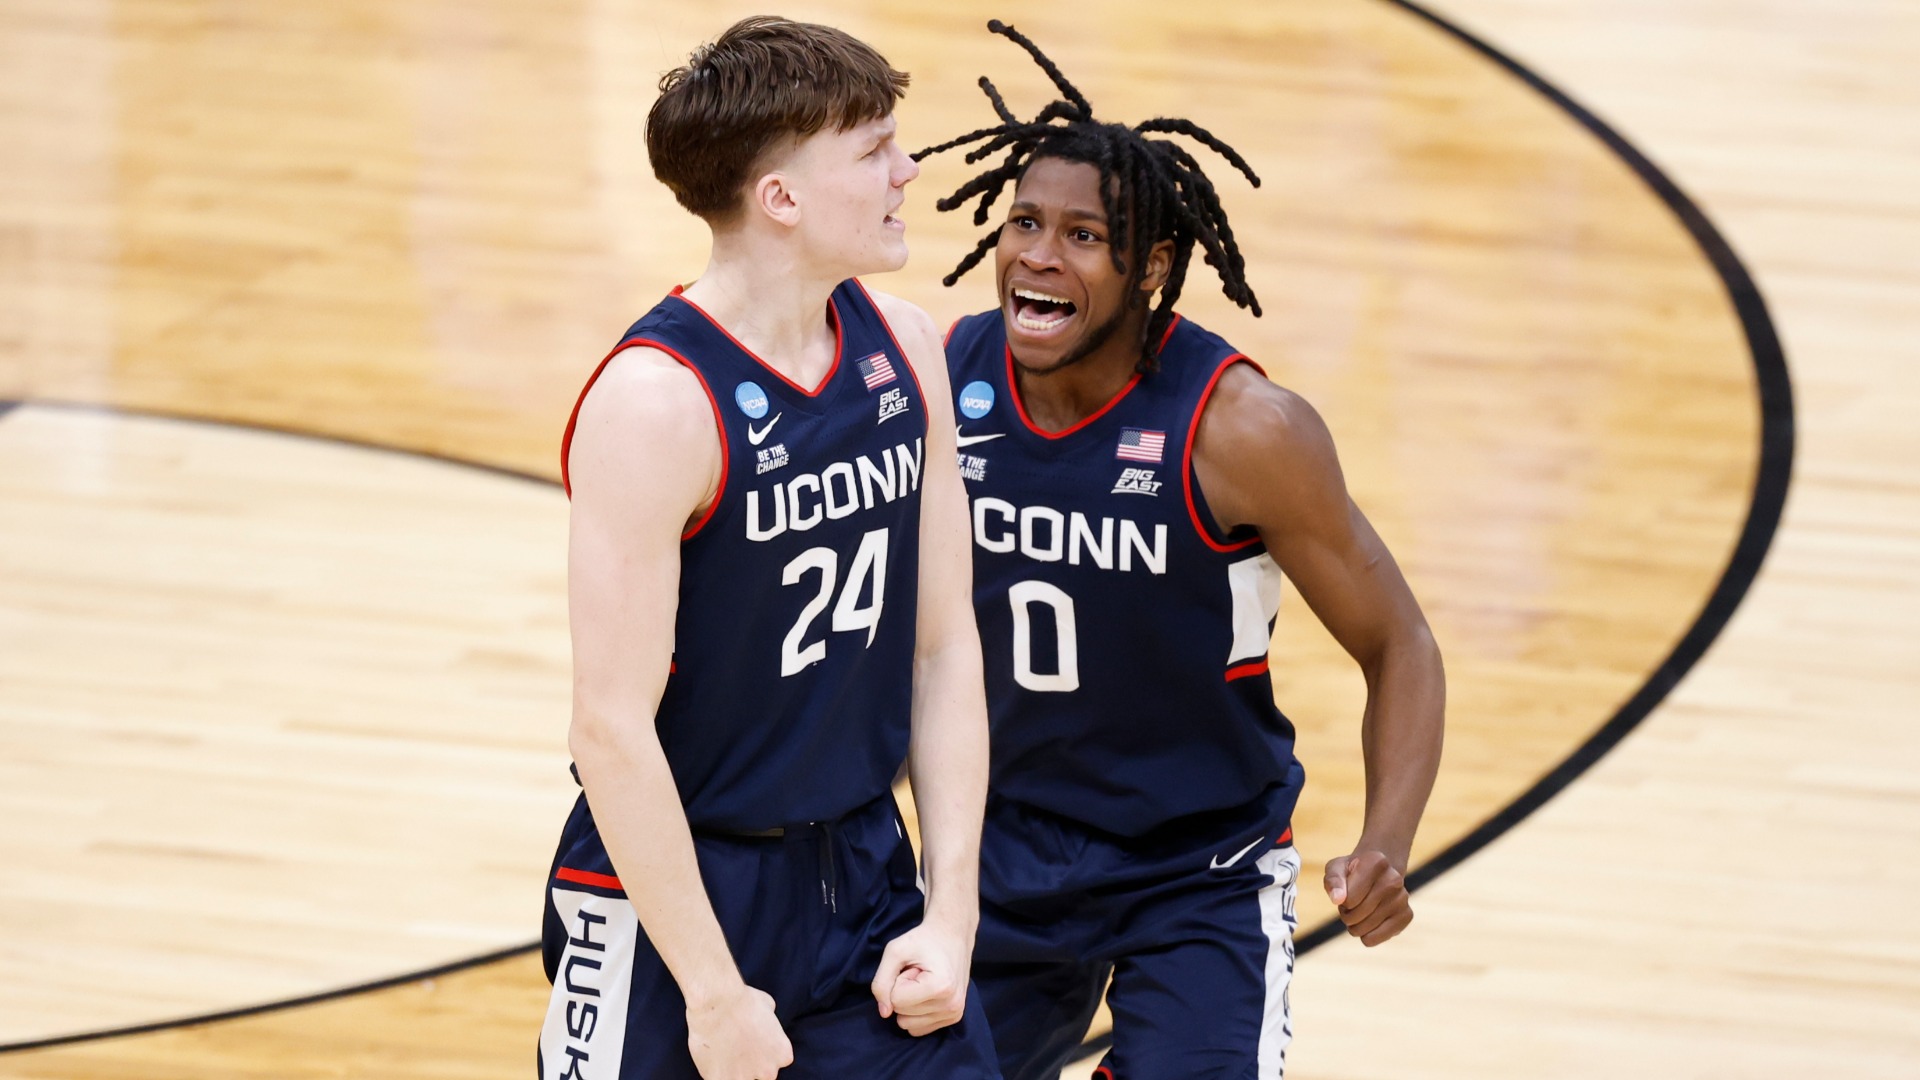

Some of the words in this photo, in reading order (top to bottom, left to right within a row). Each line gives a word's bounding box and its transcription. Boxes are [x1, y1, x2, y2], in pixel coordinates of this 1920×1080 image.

[742, 397, 767, 410] NCAA
[880, 387, 900, 406] BIG
[963, 397, 992, 411] NCAA
[878, 396, 909, 418] EAST
[757, 449, 770, 463] BE
[769, 443, 787, 459] THE
[966, 455, 987, 470] THE
[756, 454, 790, 475] CHANGE
[959, 466, 986, 481] ANGE
[1120, 467, 1155, 481] BIG
[746, 437, 922, 542] UCONN
[1114, 478, 1163, 493] EAST
[971, 496, 1168, 575] CONN
[781, 527, 889, 677] 24
[1008, 580, 1080, 693] 0
